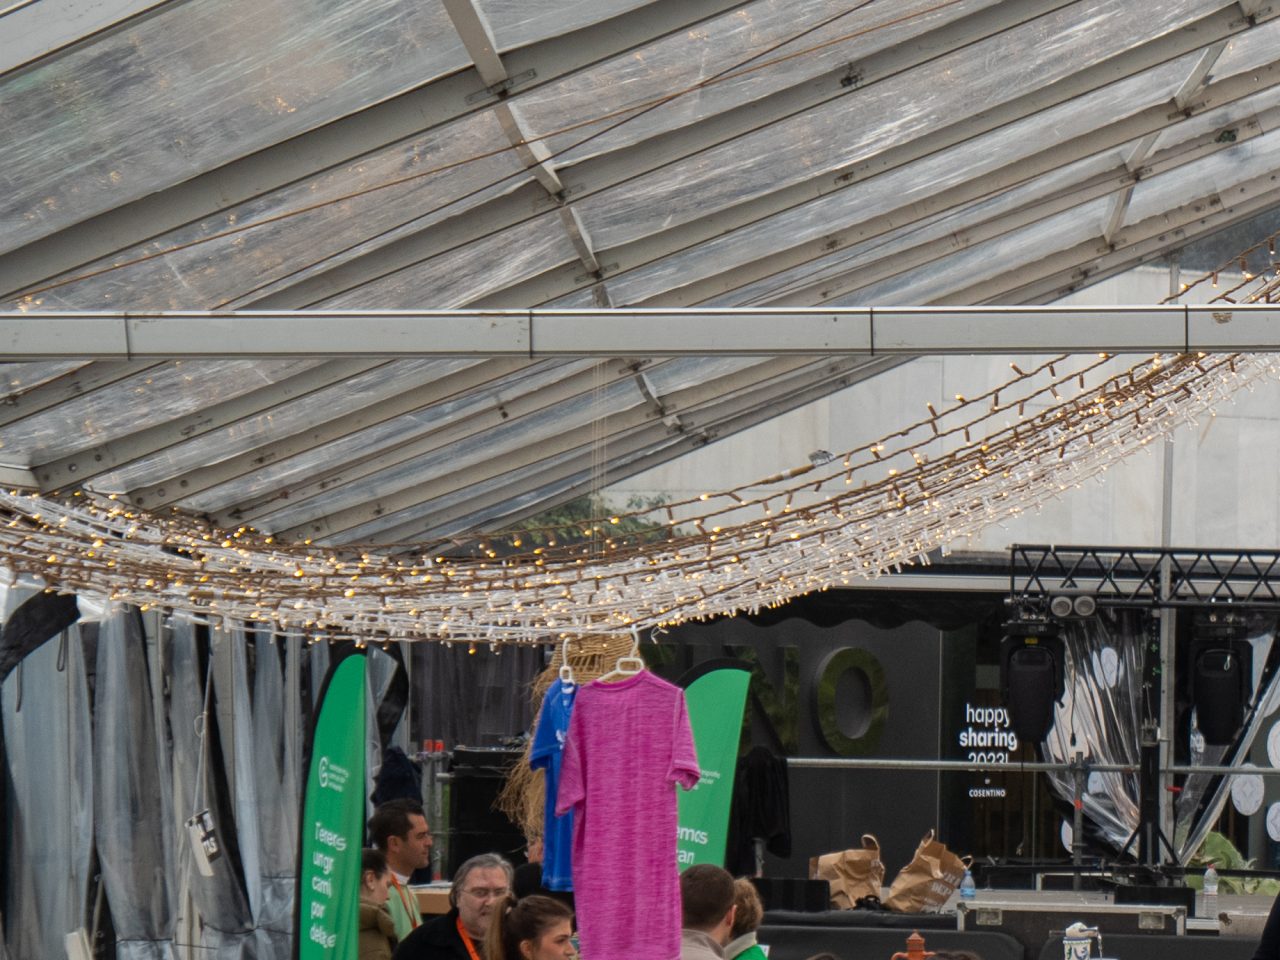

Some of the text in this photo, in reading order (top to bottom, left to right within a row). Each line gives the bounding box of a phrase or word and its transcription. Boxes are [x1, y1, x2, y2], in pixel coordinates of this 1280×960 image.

[965, 703, 1010, 728] happy
[959, 727, 1018, 751] sharing
[968, 788, 1006, 798] COSENTINO
